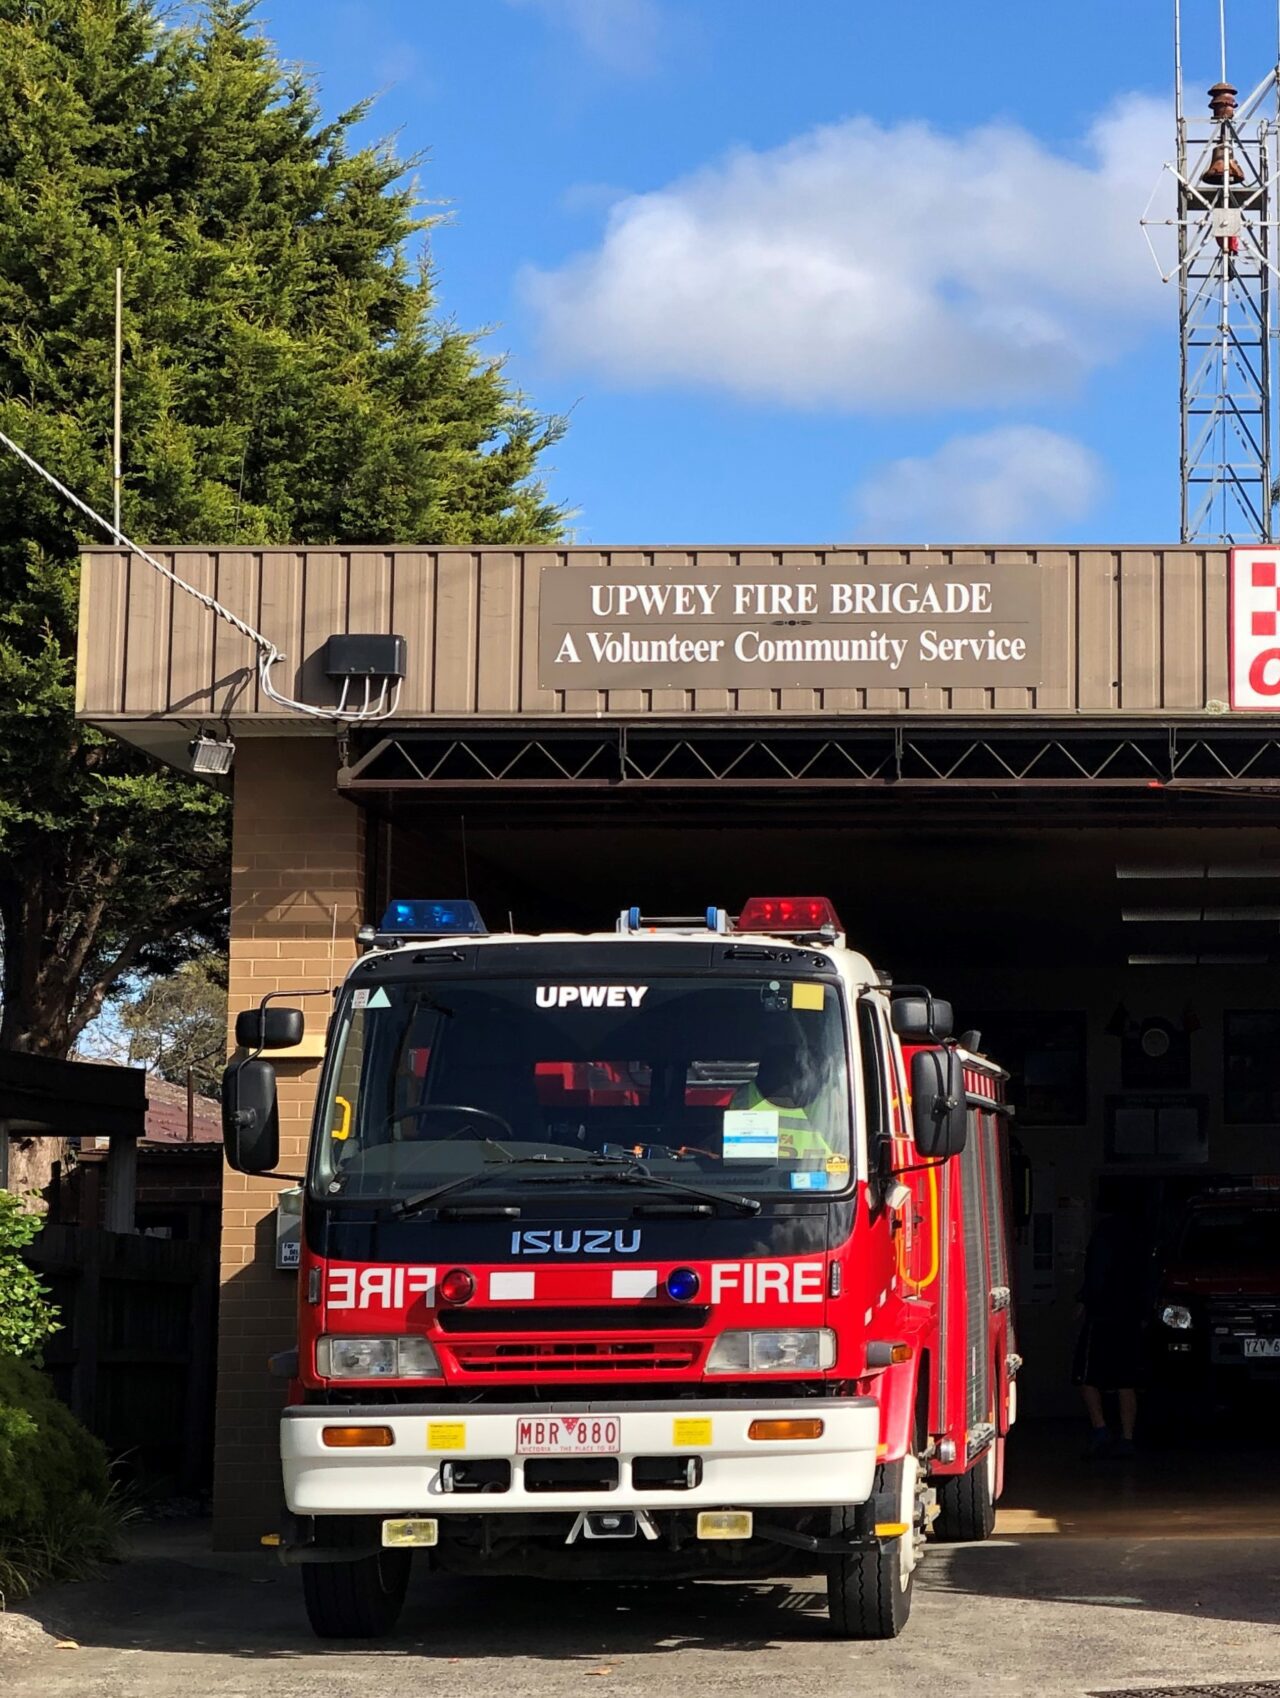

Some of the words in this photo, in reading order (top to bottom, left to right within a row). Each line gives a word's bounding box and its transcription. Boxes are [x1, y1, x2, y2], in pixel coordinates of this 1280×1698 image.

[590, 584, 722, 616] UPWEY
[733, 584, 818, 615] FIRE
[830, 582, 993, 614] BRIGADE
[554, 633, 581, 663] A
[586, 632, 725, 663] Volunteer
[735, 631, 908, 670] Community
[920, 630, 1026, 662] Service
[535, 986, 648, 1007] UPWEY
[511, 1230, 641, 1254] ISUZU
[711, 1262, 823, 1304] FIRE
[520, 1422, 559, 1444] MBR
[577, 1422, 616, 1444] 880
